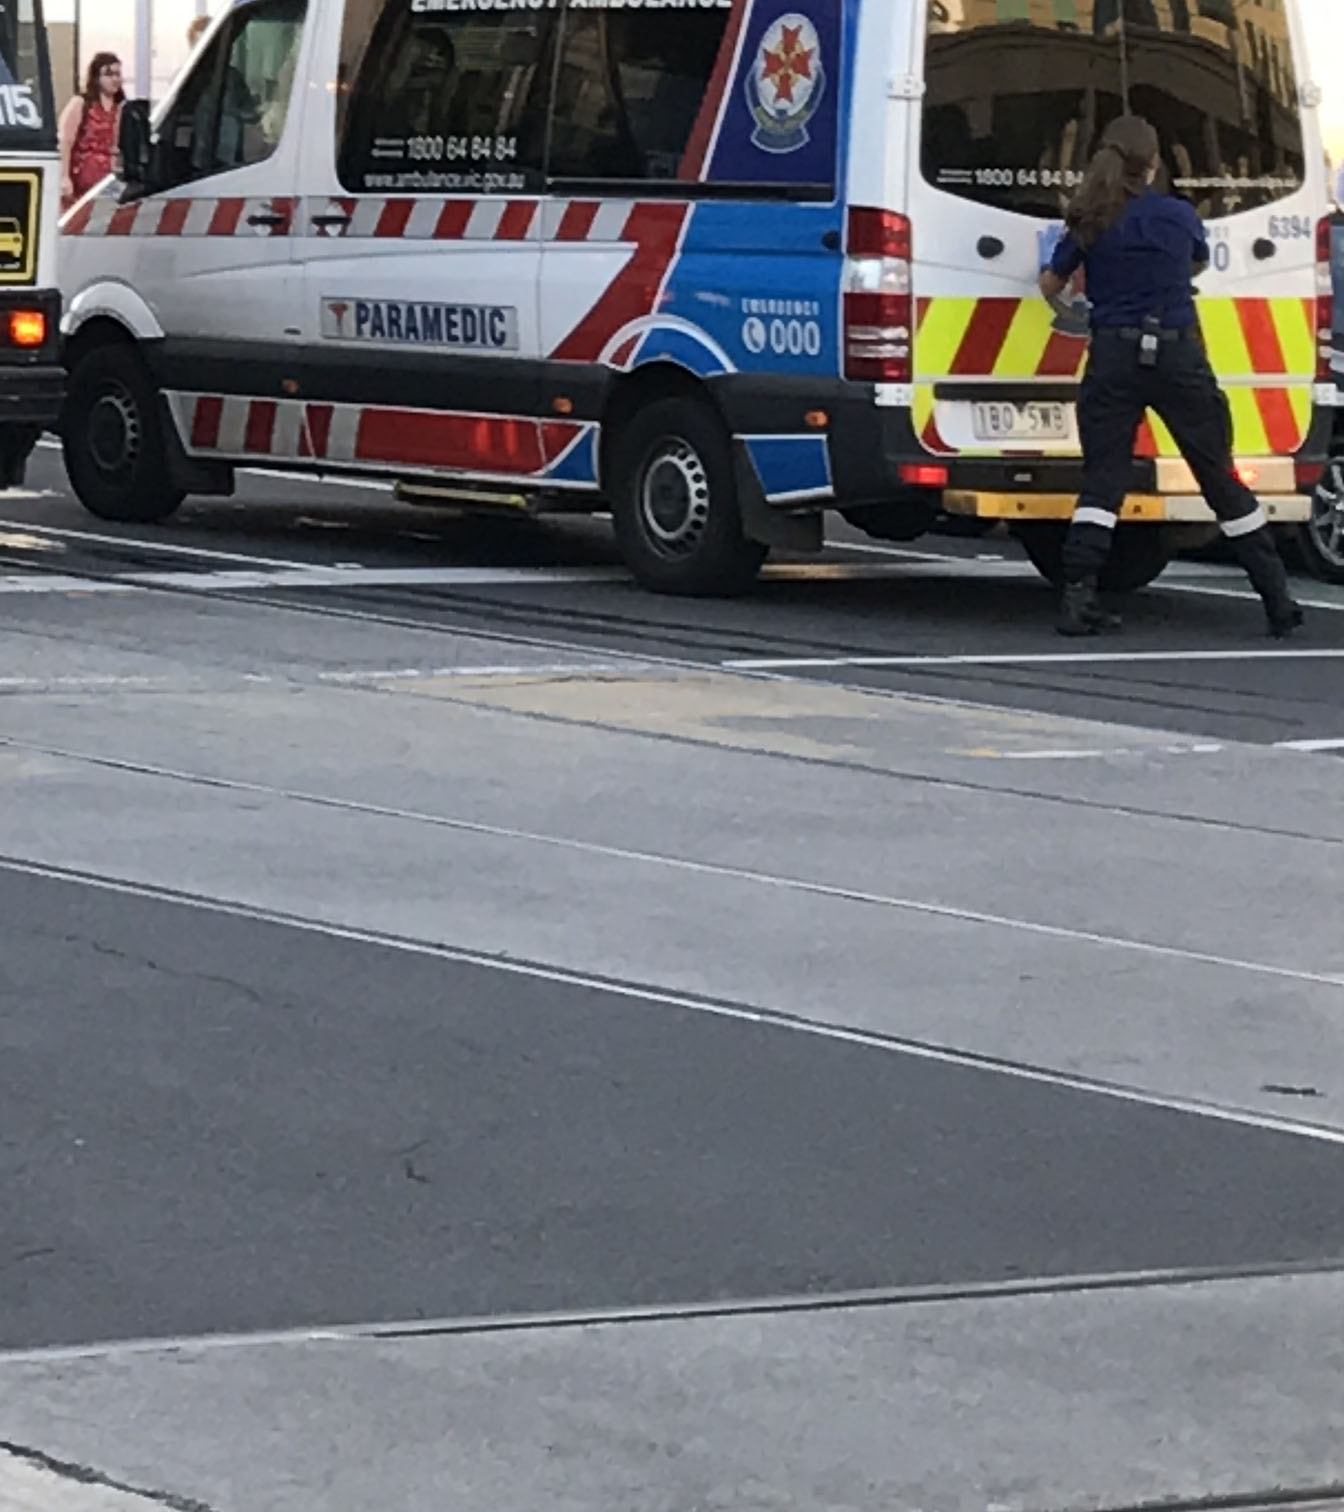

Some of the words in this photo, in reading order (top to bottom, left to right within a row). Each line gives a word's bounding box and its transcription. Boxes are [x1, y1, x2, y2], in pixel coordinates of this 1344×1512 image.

[407, 136, 443, 161] 1800
[447, 136, 468, 161] 64
[472, 136, 491, 161] 84
[495, 136, 517, 161] 84
[974, 168, 1013, 186] 1800
[1016, 168, 1037, 186] 64
[1268, 215, 1311, 239] 6394
[356, 303, 506, 347] PARAMEDIC
[770, 318, 820, 356] 000
